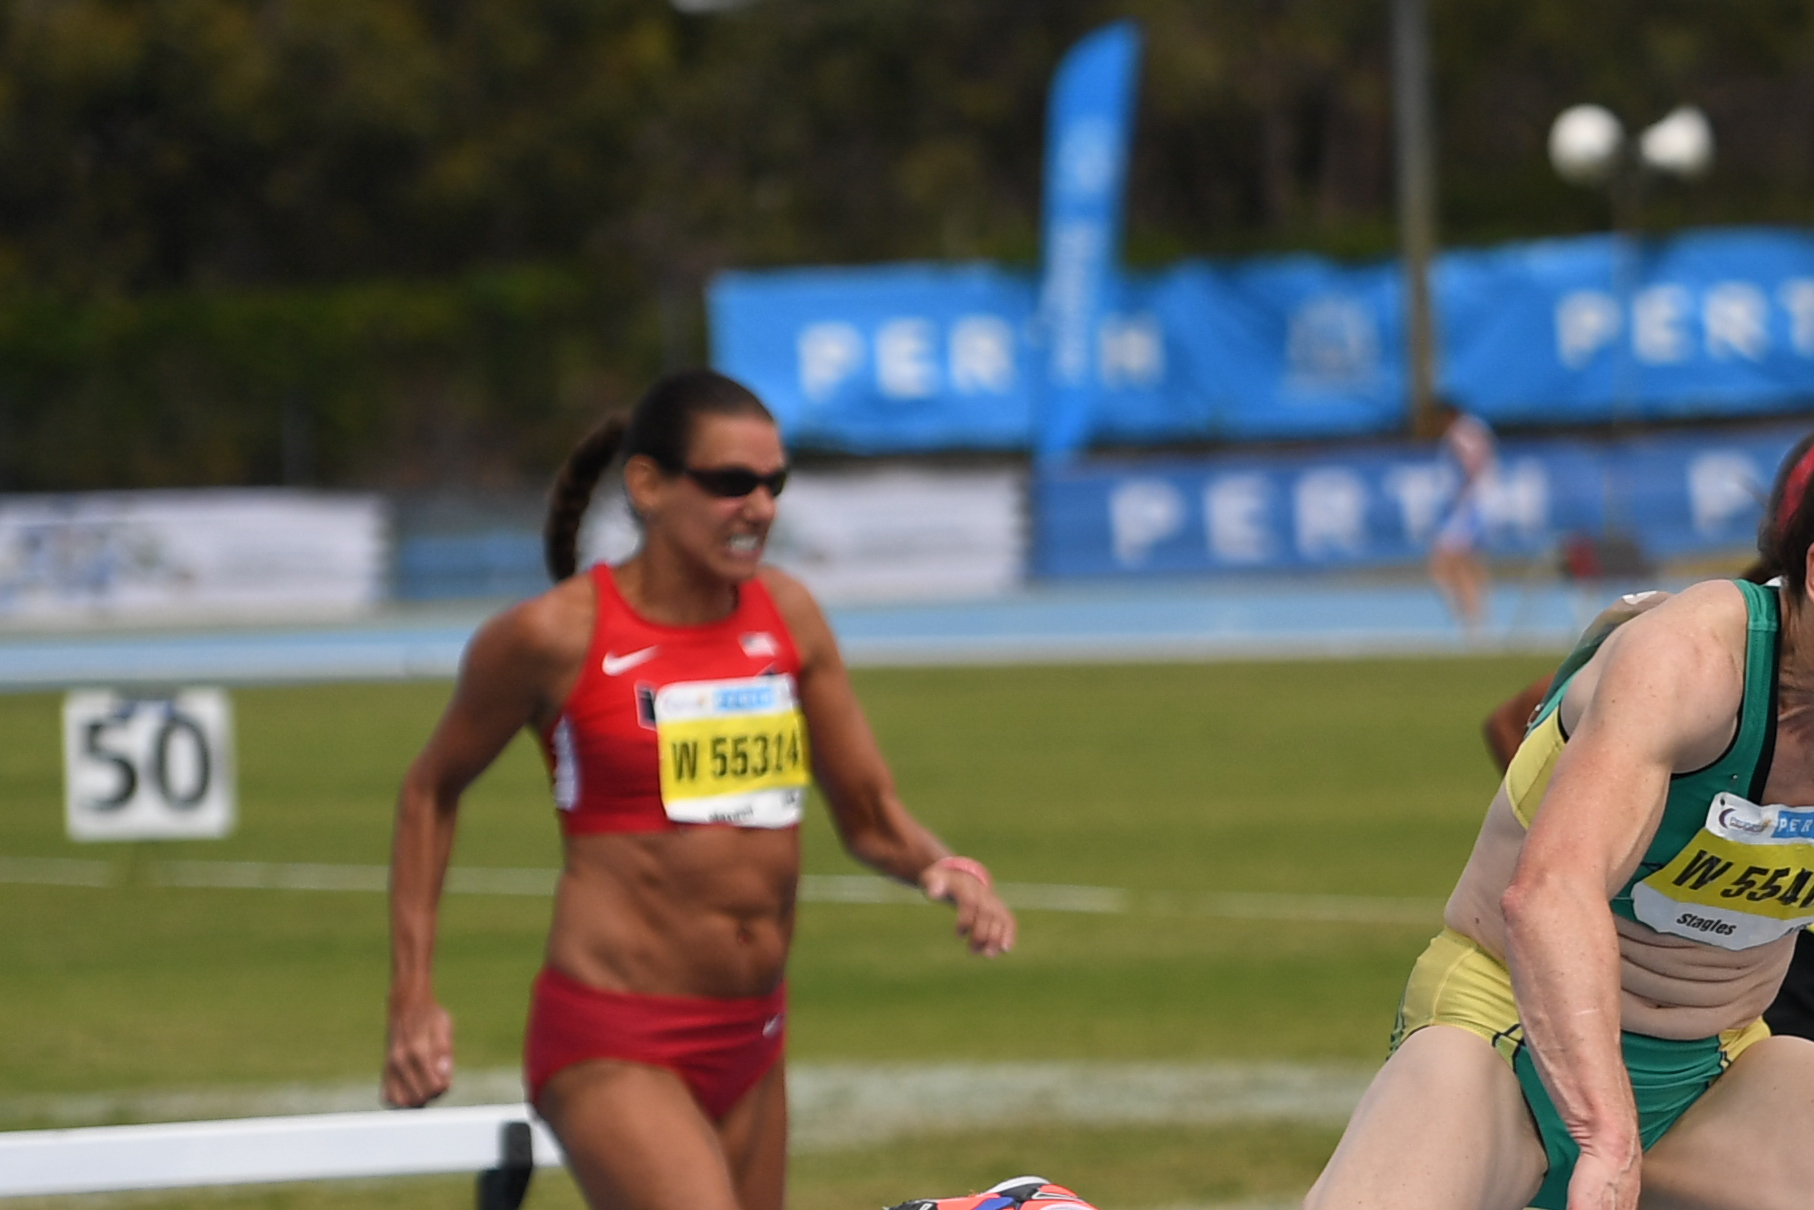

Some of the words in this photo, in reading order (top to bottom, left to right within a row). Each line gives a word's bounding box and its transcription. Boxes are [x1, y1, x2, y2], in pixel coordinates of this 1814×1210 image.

[798, 315, 1164, 402] PERH
[82, 716, 211, 814] 50
[672, 741, 698, 782] W
[710, 730, 799, 777] 55314
[1672, 850, 1732, 890] W
[1676, 912, 1737, 936] Stagles
